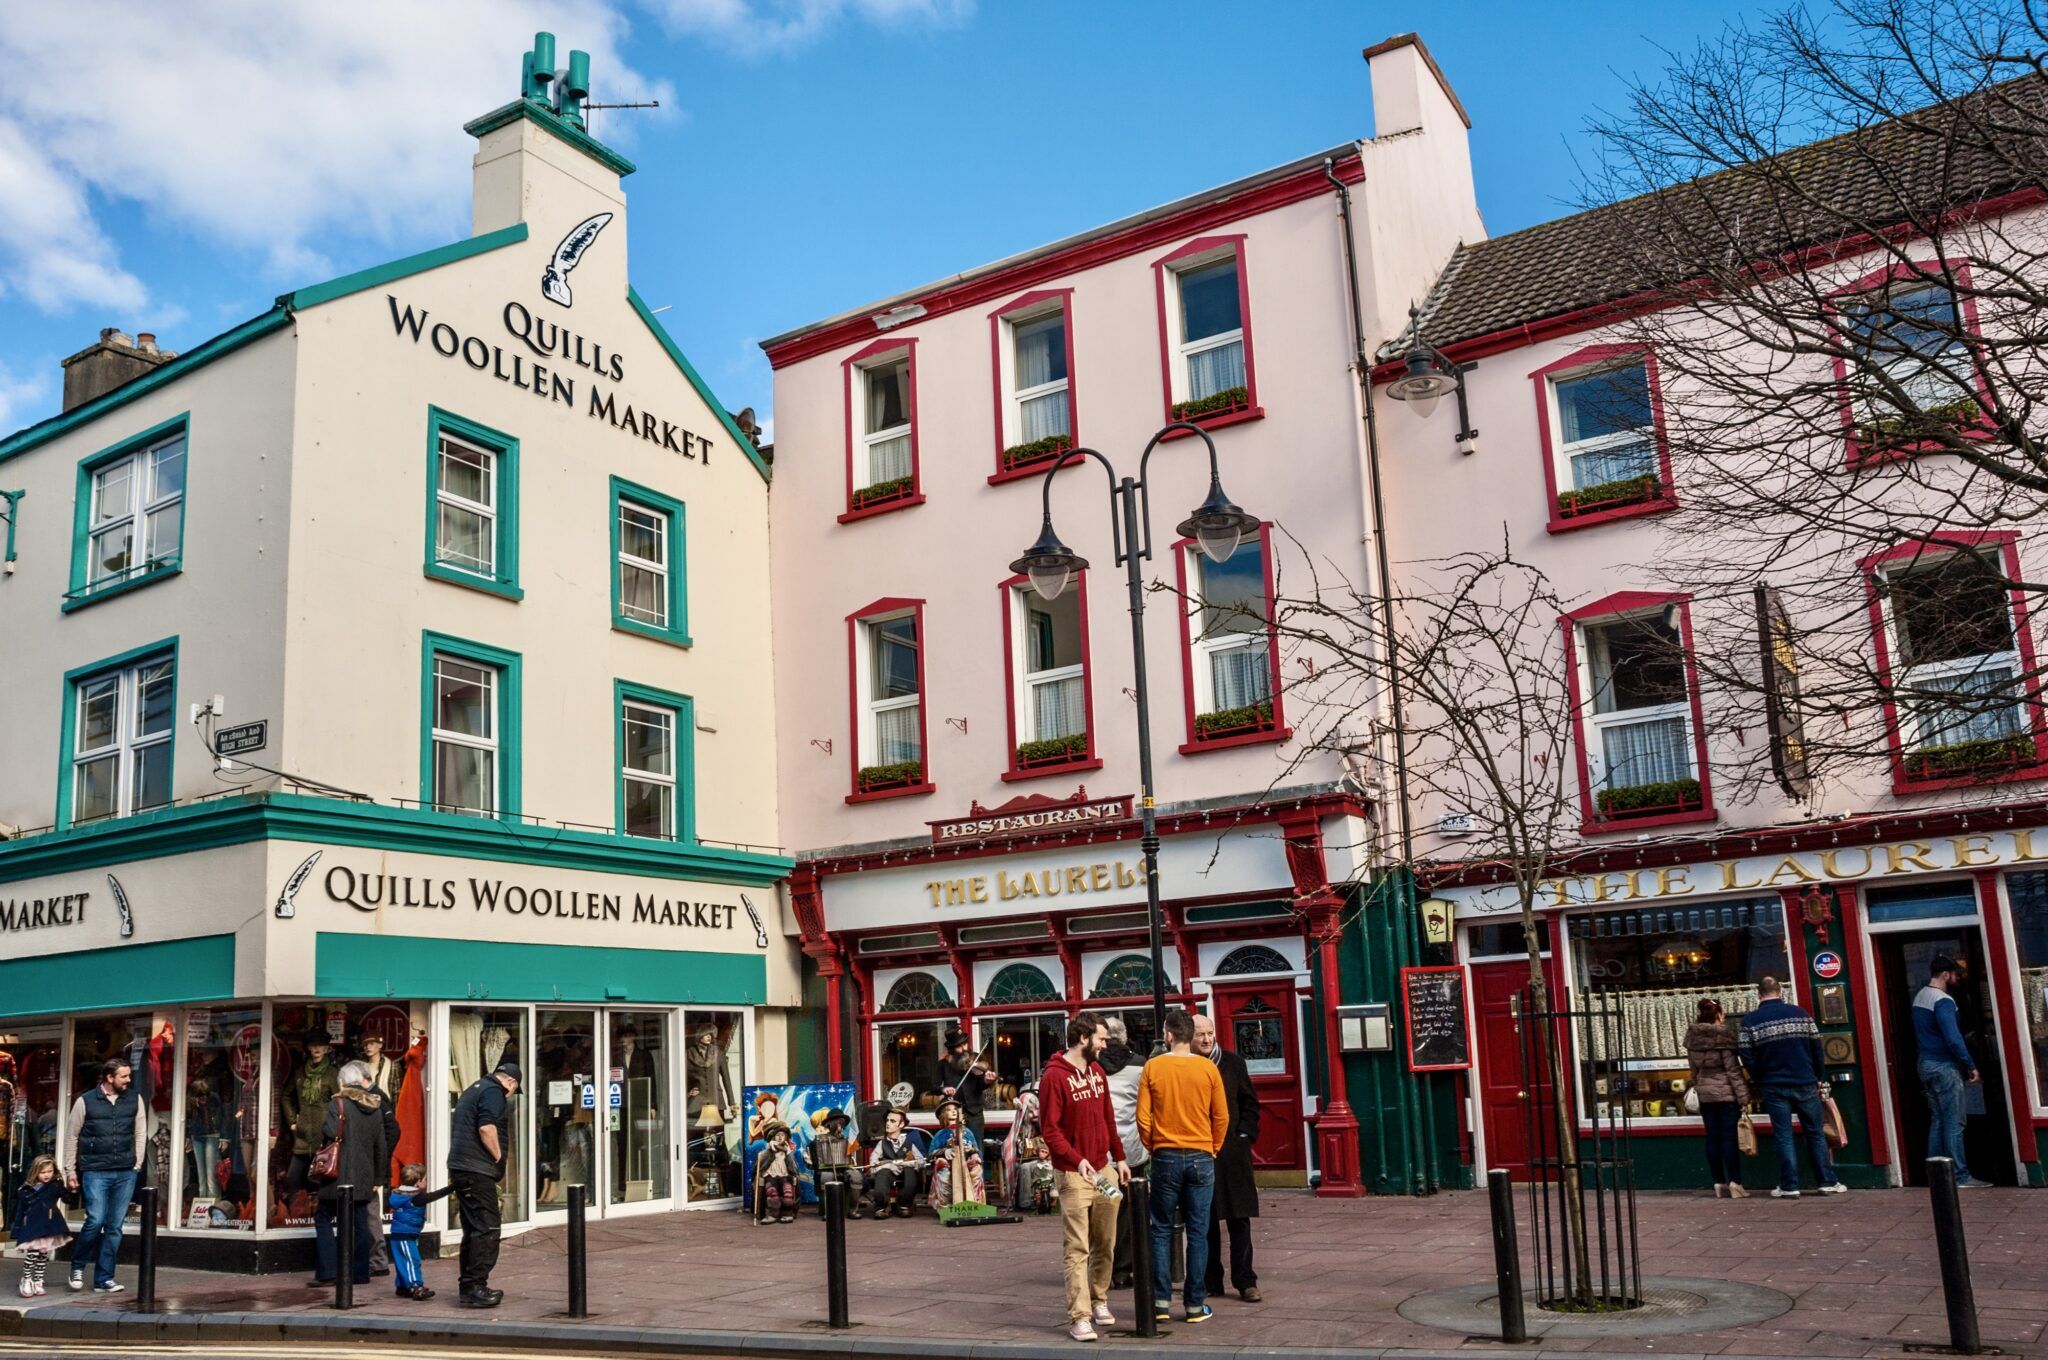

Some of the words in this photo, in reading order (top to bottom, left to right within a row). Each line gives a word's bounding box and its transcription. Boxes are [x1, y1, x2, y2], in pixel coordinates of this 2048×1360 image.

[503, 301, 624, 382] QUILLS
[387, 294, 575, 407] WOOLLEN
[588, 385, 713, 465] MARKET
[221, 740, 236, 751] HIGH
[237, 736, 259, 748] STREET
[940, 802, 1122, 839] RESTAURANT
[325, 865, 456, 912] QUILLS
[469, 878, 621, 920] WOOLLEN
[631, 892, 737, 930] MARKET
[926, 875, 989, 908] THE
[1534, 865, 1695, 907] THE
[0, 892, 90, 932] MARKET
[1072, 1089, 1091, 1101] CITY
[949, 1205, 978, 1213] THANK
